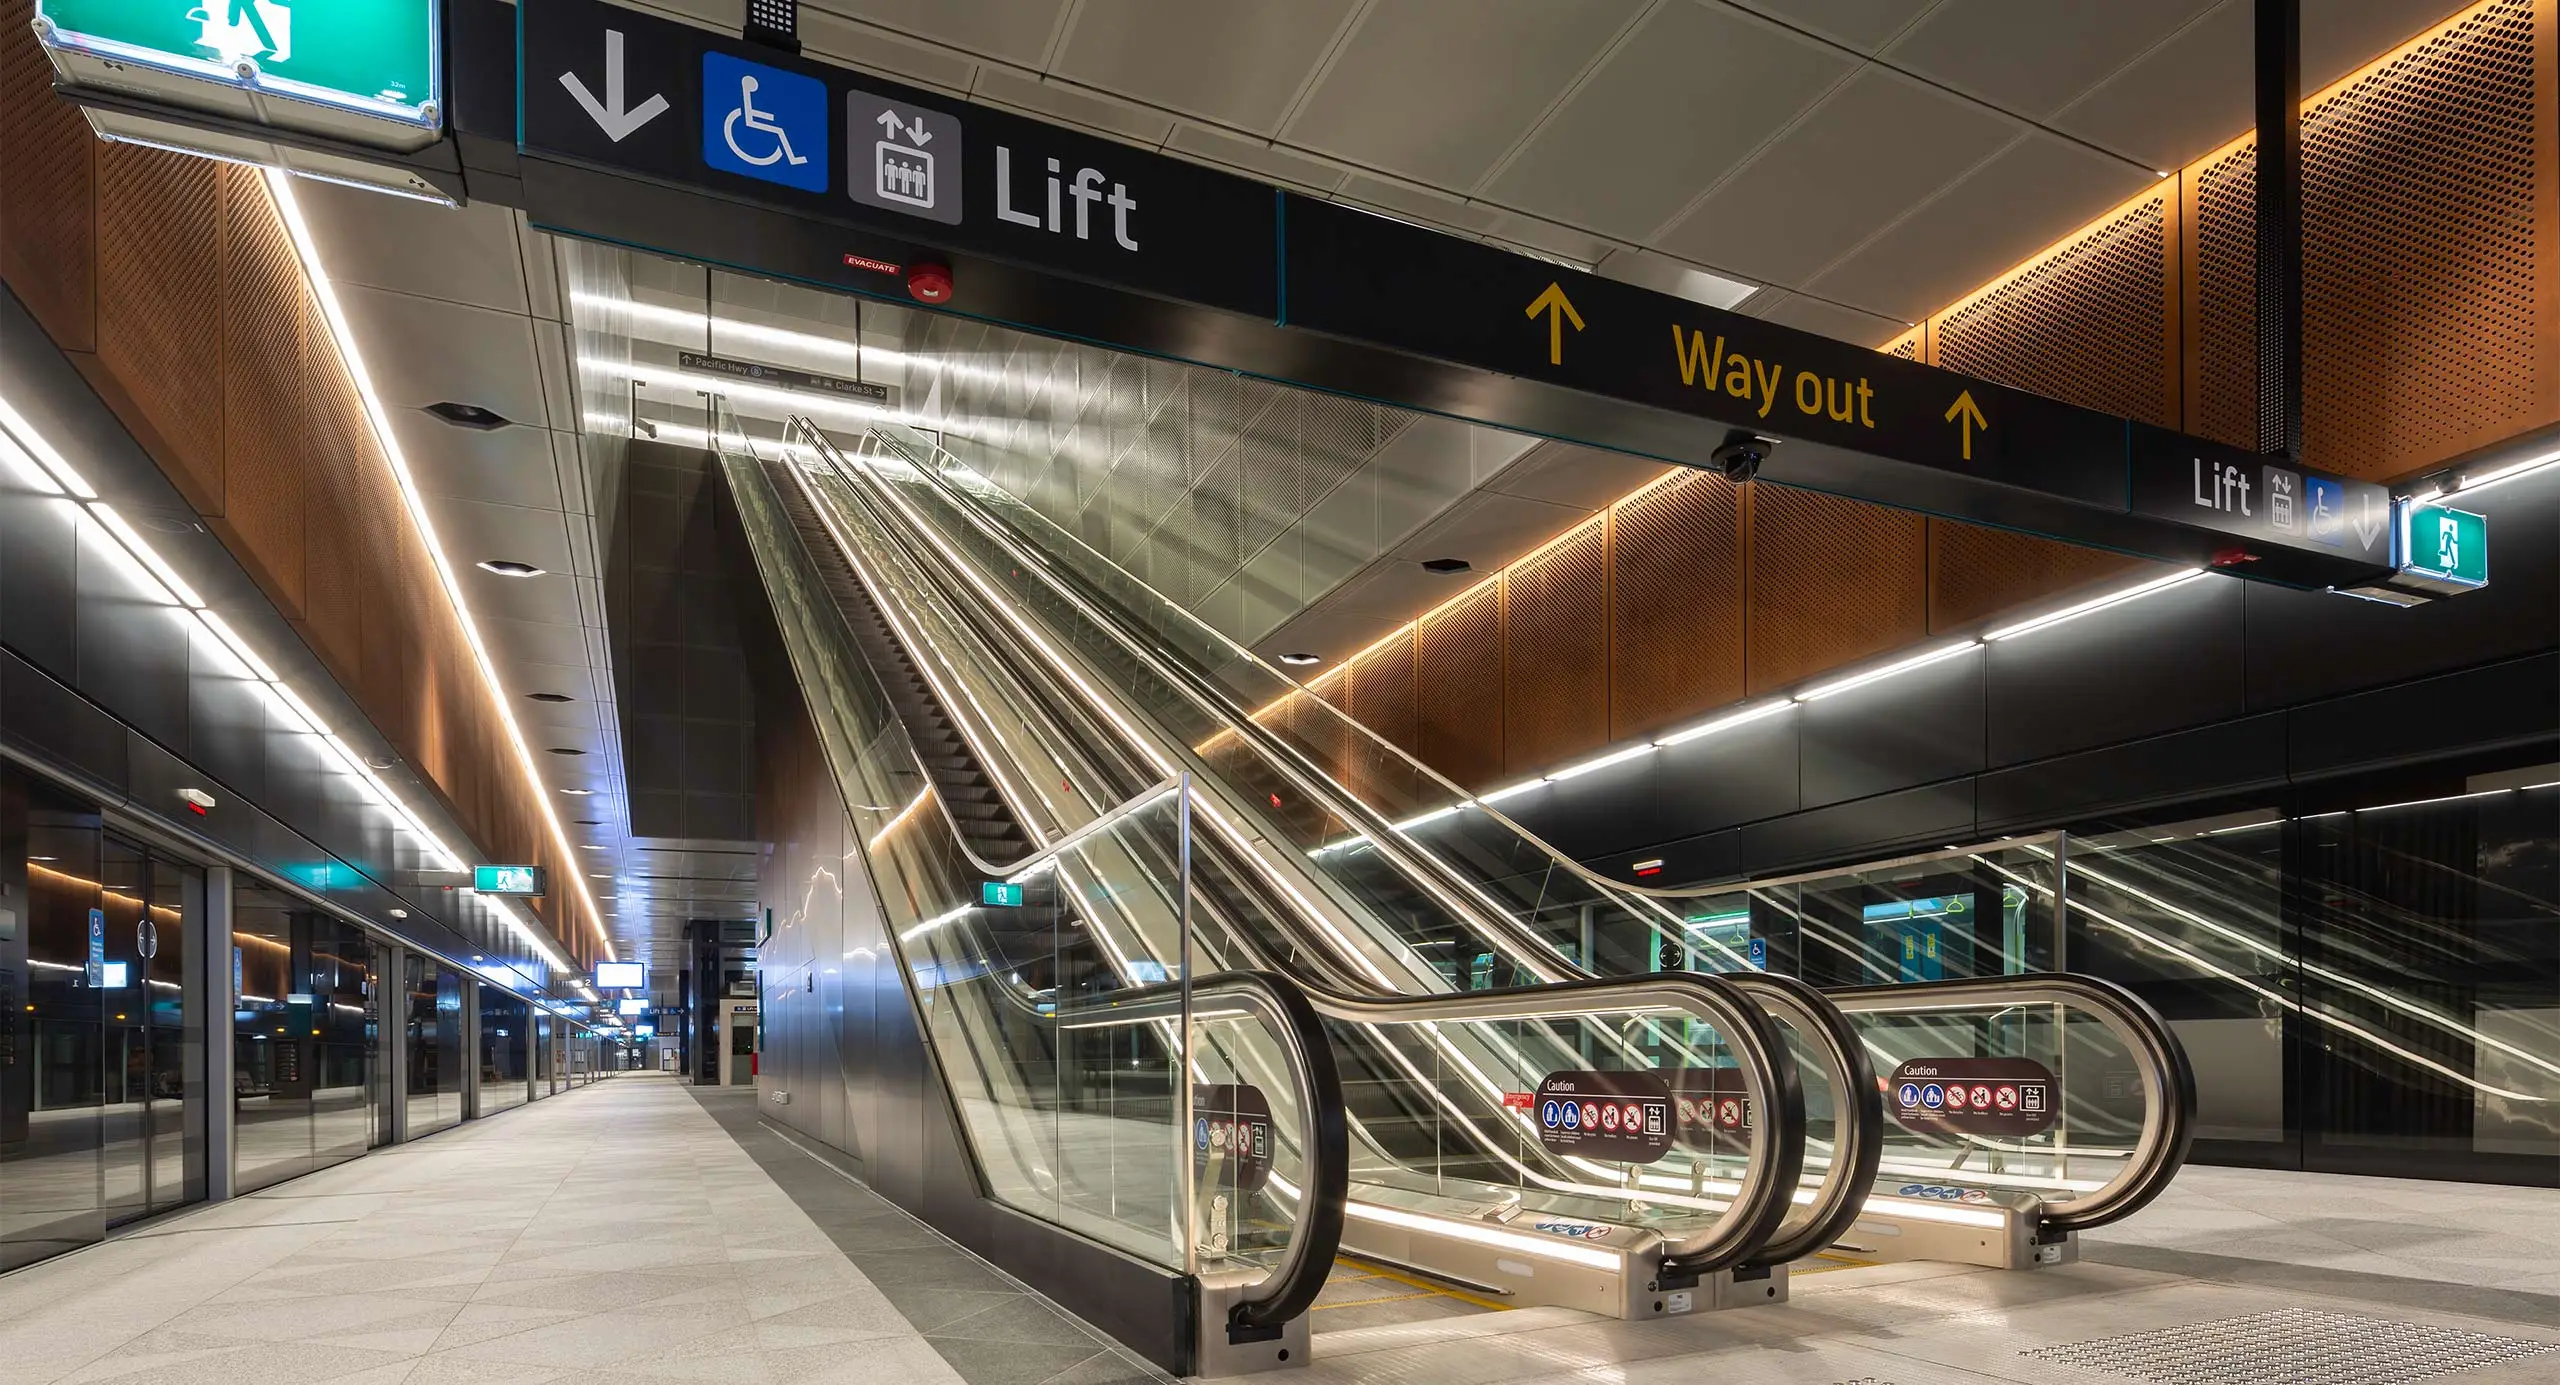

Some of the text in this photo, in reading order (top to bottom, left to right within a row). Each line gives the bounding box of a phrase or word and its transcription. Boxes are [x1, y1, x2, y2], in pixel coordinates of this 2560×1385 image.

[996, 145, 1138, 251] Lift
[848, 257, 896, 273] EVACUATE
[695, 357, 727, 371] Pacific
[728, 362, 748, 375] Hwy
[1672, 324, 1875, 429] Way out
[835, 381, 873, 395] Clarke St
[2194, 457, 2251, 517] Lift
[585, 979, 591, 987] 2
[1903, 1065, 1938, 1077] Caution
[1546, 1079, 1575, 1092] Caution
